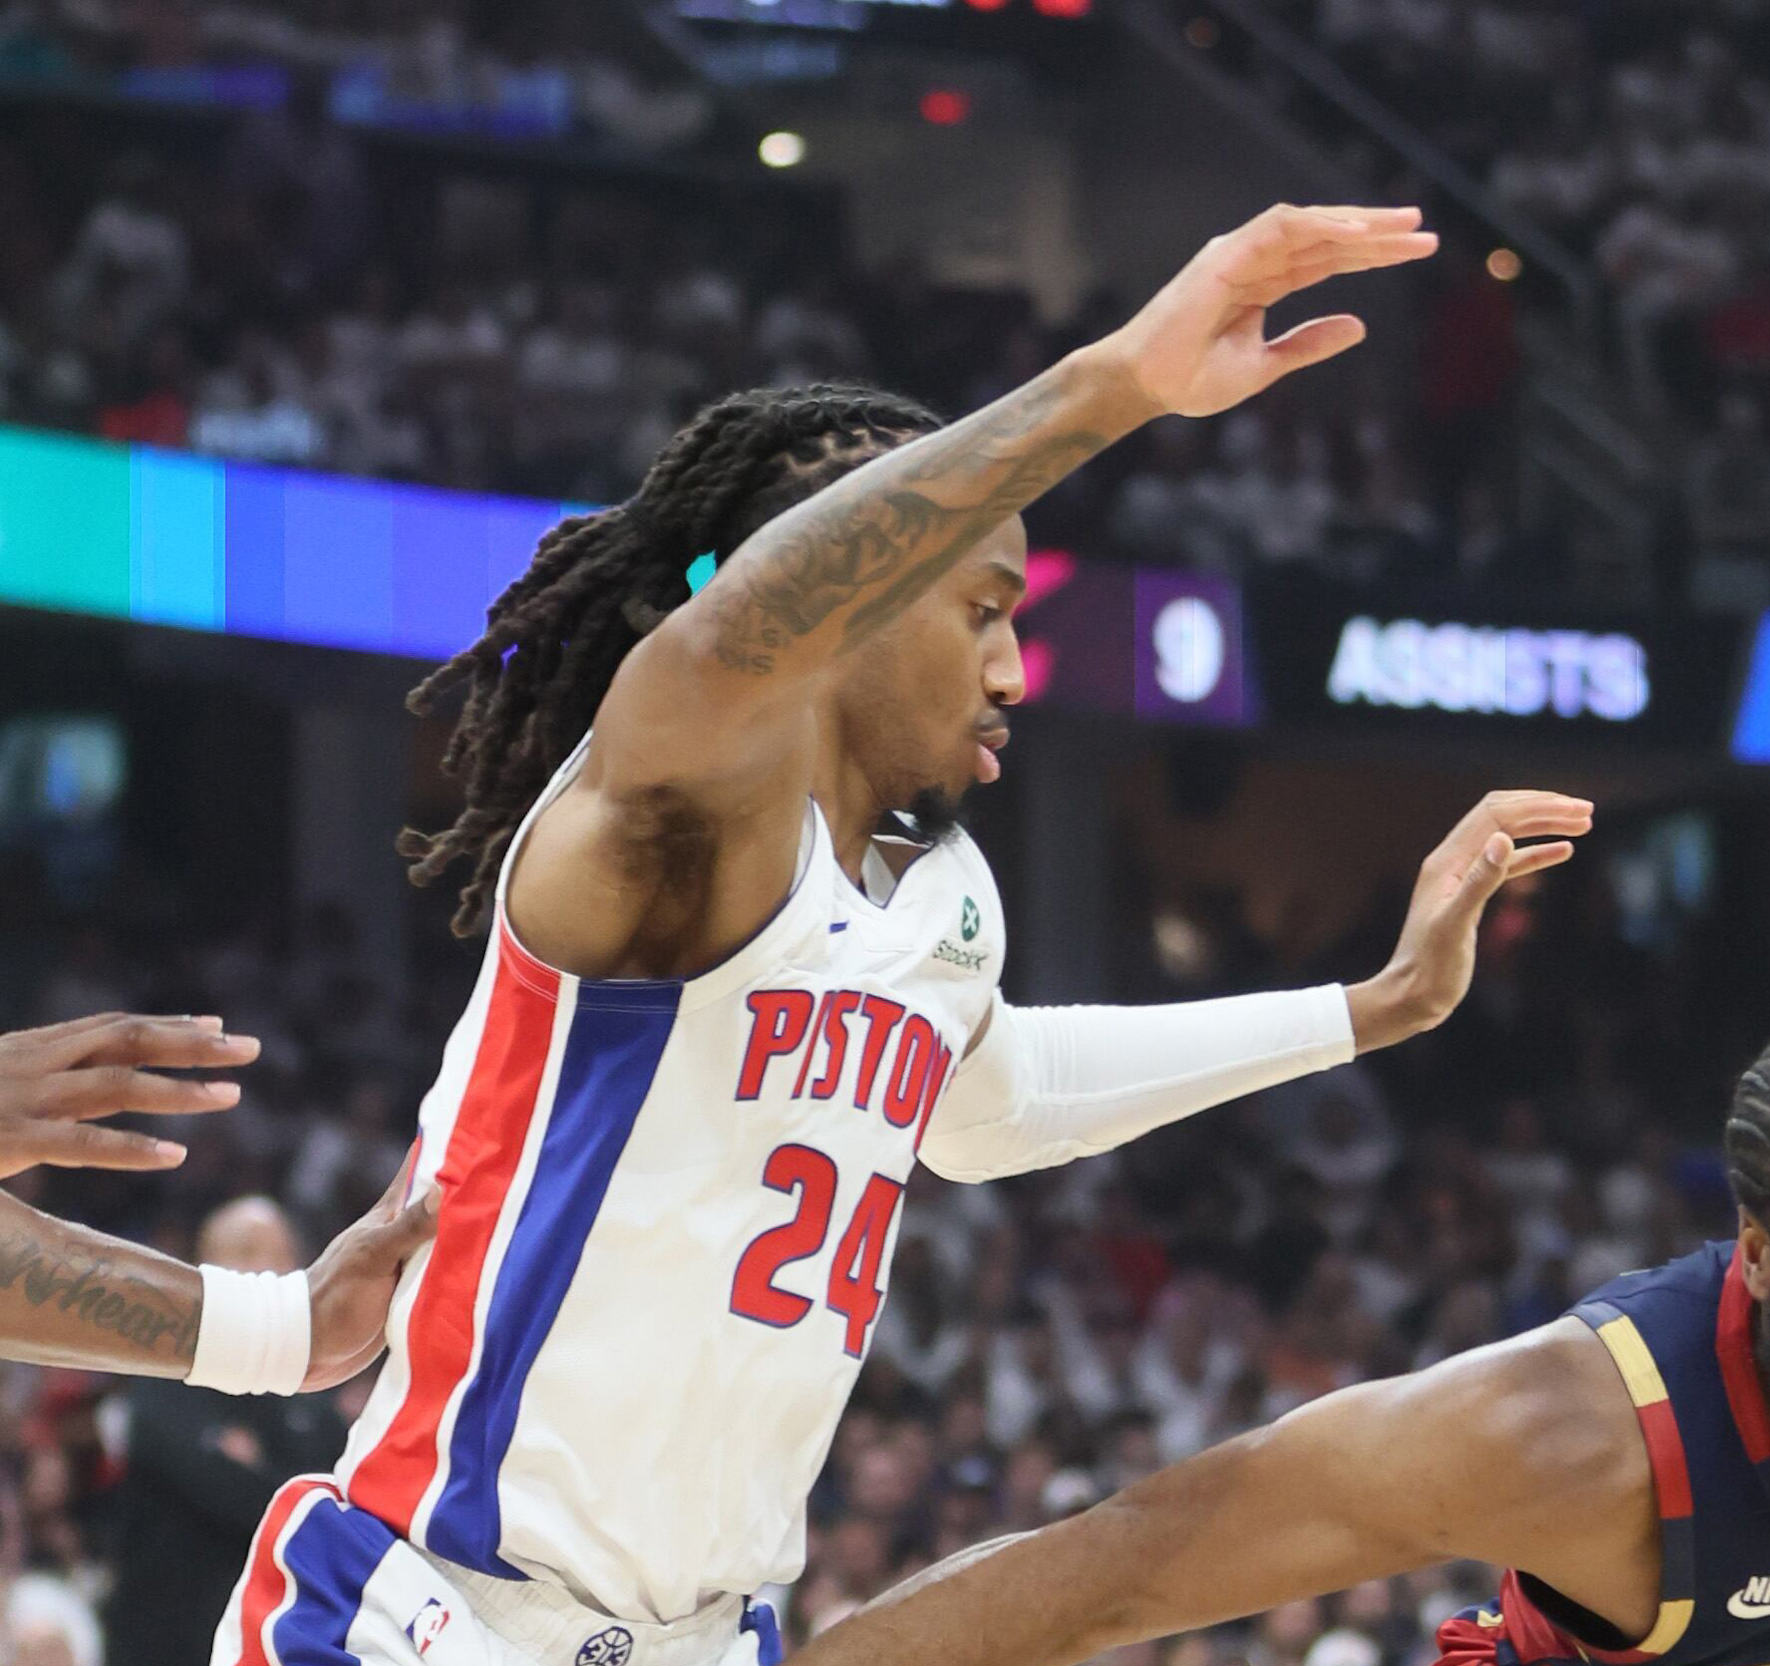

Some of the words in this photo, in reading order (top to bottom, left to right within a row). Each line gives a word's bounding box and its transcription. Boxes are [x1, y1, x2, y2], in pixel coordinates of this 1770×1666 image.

[1154, 598, 1224, 702] 9
[1328, 616, 1649, 720] ASSISTS
[729, 1143, 905, 1360] 24
